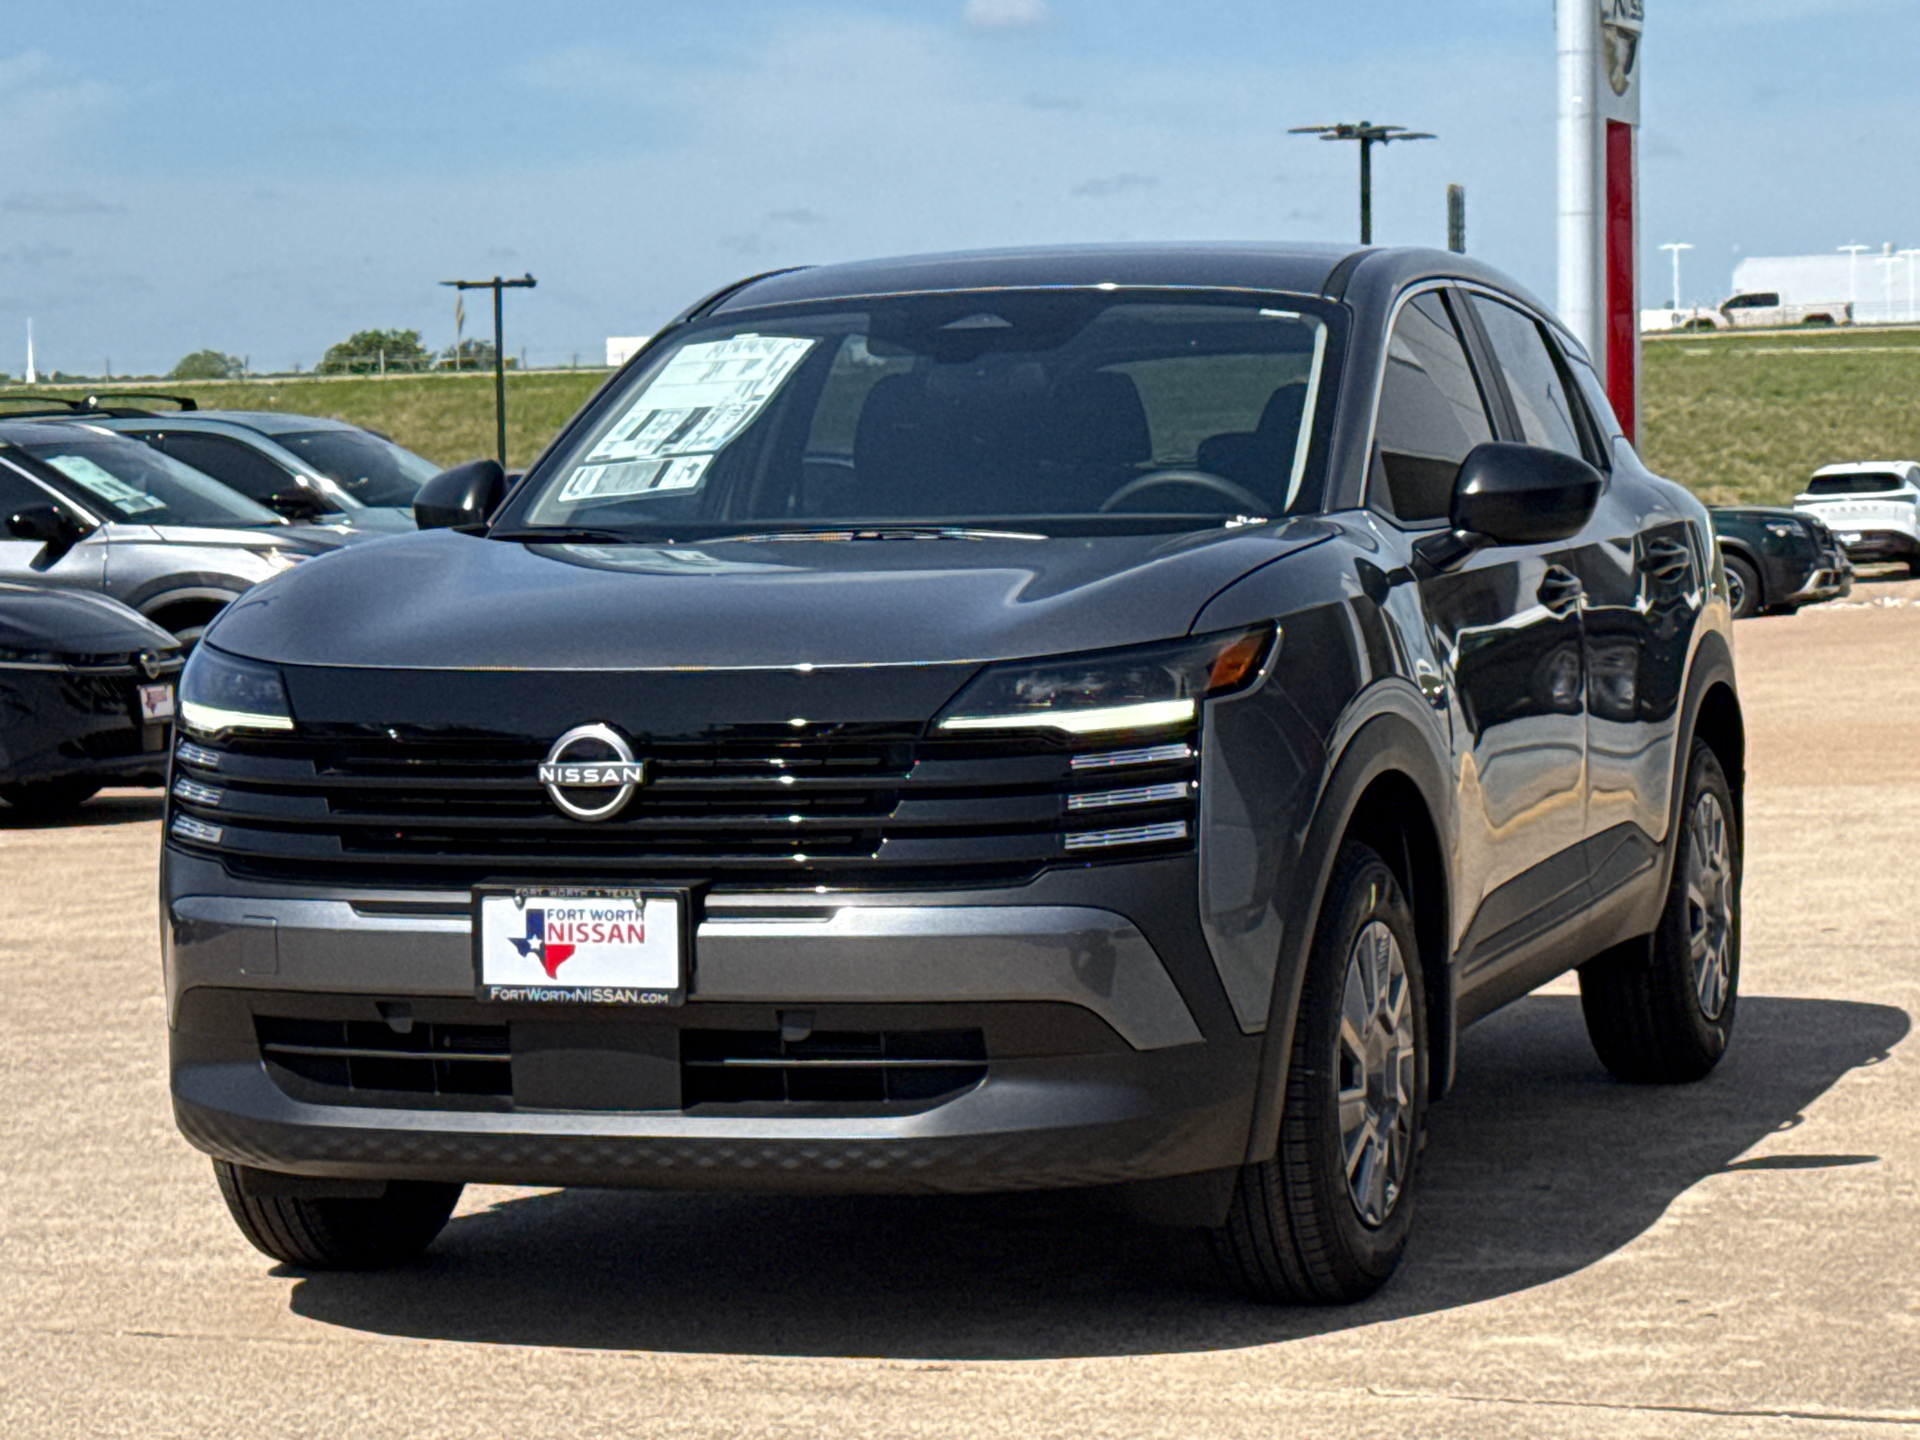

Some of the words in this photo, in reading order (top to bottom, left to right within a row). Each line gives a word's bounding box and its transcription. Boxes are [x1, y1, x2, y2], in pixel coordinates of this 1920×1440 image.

[539, 767, 641, 782] NISSAN
[547, 909, 586, 921] FORT
[590, 909, 645, 922] WORTH
[547, 923, 645, 944] NISSAN
